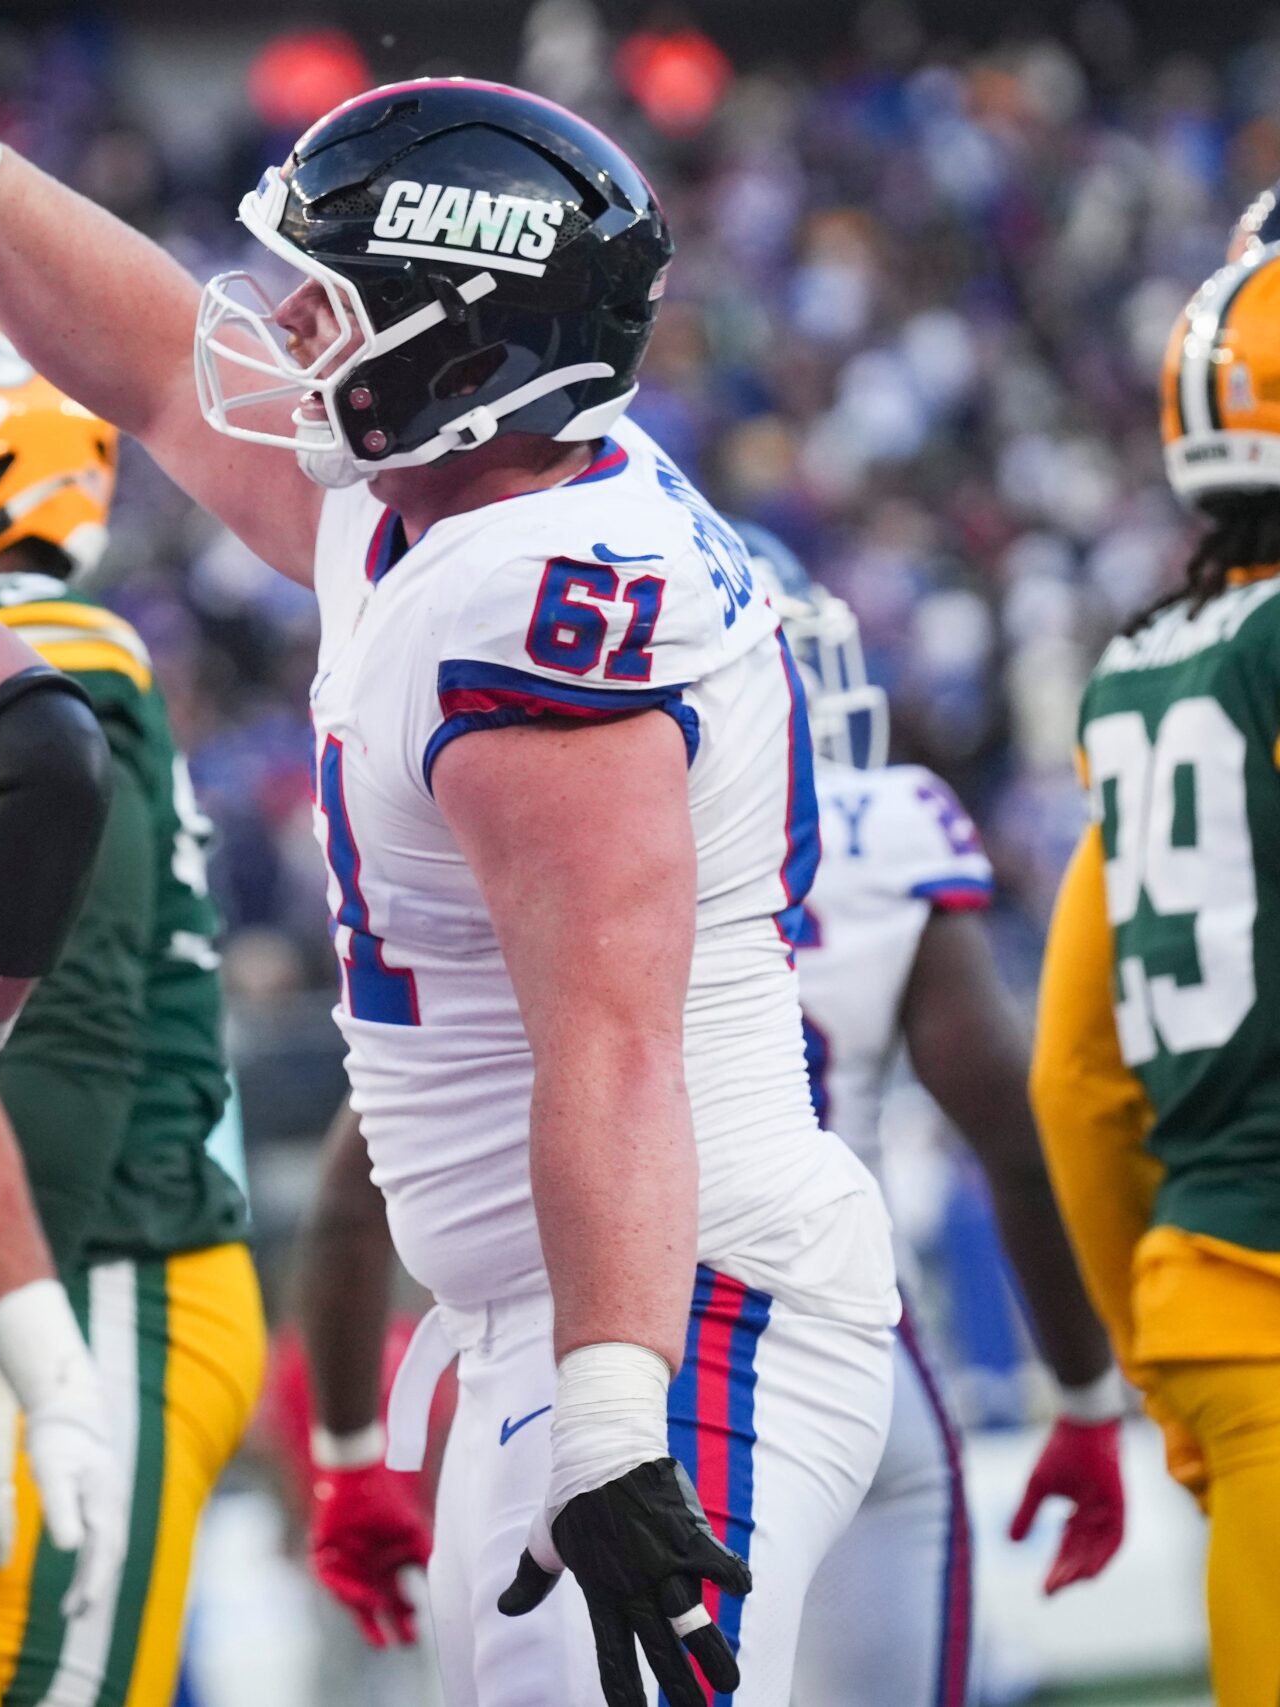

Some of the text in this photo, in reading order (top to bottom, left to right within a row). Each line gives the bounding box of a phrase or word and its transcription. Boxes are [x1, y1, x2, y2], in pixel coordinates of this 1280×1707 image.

[373, 180, 564, 261] GIANTS
[524, 556, 666, 682] 61
[310, 708, 421, 1027] 1
